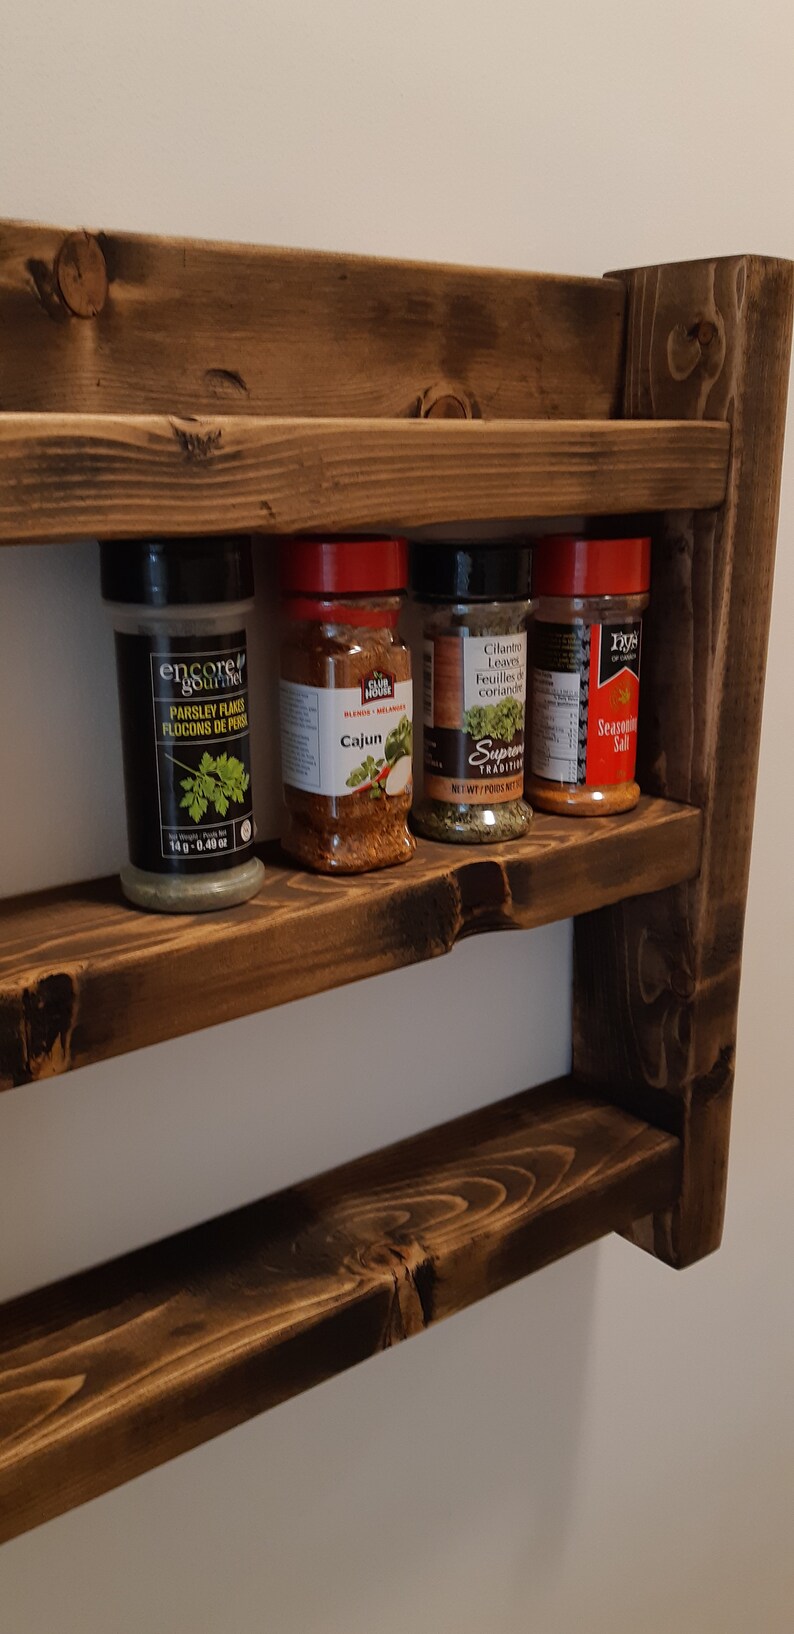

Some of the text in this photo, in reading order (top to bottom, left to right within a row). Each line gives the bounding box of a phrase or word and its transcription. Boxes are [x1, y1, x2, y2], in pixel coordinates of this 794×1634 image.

[484, 642, 522, 656] Cilantro
[488, 656, 520, 669] Leaves
[160, 659, 235, 683] encore
[476, 671, 516, 685] Feuilles
[181, 672, 243, 697] gourmet
[368, 678, 389, 690] CLUB
[478, 683, 523, 698] coriandre
[365, 686, 392, 700] HOUSE
[169, 697, 245, 721] PARSLEY FLAKES
[343, 709, 371, 719] BLENDS
[162, 720, 212, 737] FLOCONS
[213, 718, 227, 734] DE
[340, 732, 382, 750] Cajun
[613, 733, 630, 753] Salt
[451, 783, 464, 795] NET
[466, 784, 479, 795] WT
[484, 783, 505, 795] POIDS
[169, 840, 181, 852] 14
[196, 838, 217, 851] 0.49
